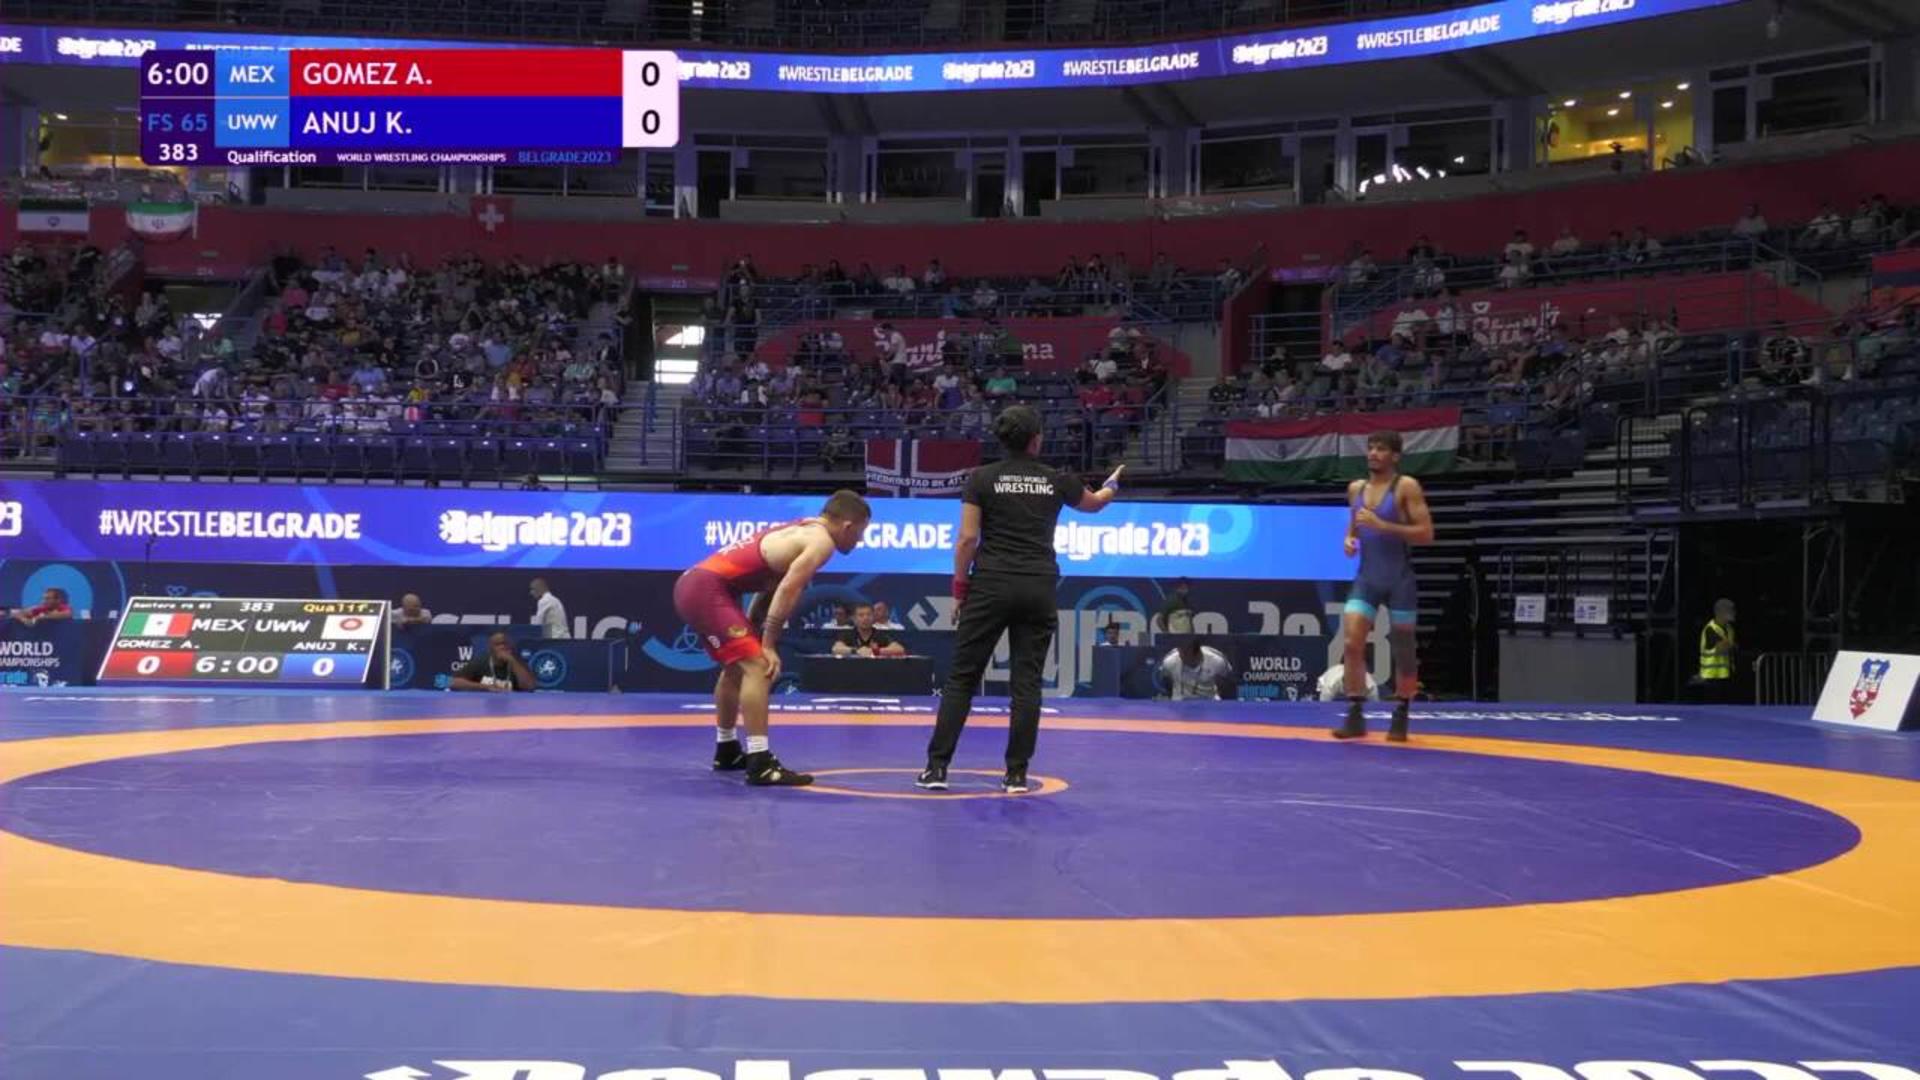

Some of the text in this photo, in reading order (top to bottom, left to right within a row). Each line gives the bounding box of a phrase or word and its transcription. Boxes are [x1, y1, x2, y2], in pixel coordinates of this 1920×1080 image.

[1357, 16, 1500, 49] #WRESTLEBELGRADE
[1063, 52, 1199, 75] #WRESTLEBELGRADE
[779, 65, 912, 82] #WRESTLEBELGRADE
[994, 482, 1054, 495] WRESTLING
[99, 510, 361, 538] #WRESTLEBELGRADE
[446, 510, 568, 551] Belgrade
[1053, 522, 1148, 560] elgrade
[239, 603, 274, 612] 383
[304, 603, 375, 613] Qualif.
[192, 619, 245, 632] MEX
[255, 620, 310, 632] UWW
[117, 640, 200, 649] GOMEZ A.
[293, 642, 366, 651] ANUJ K.
[136, 656, 161, 674] 0
[196, 656, 279, 674] 6:00
[312, 658, 335, 676] 0
[1250, 656, 1302, 671] WORLD
[1243, 671, 1308, 681] CHAMPIONSHIPS
